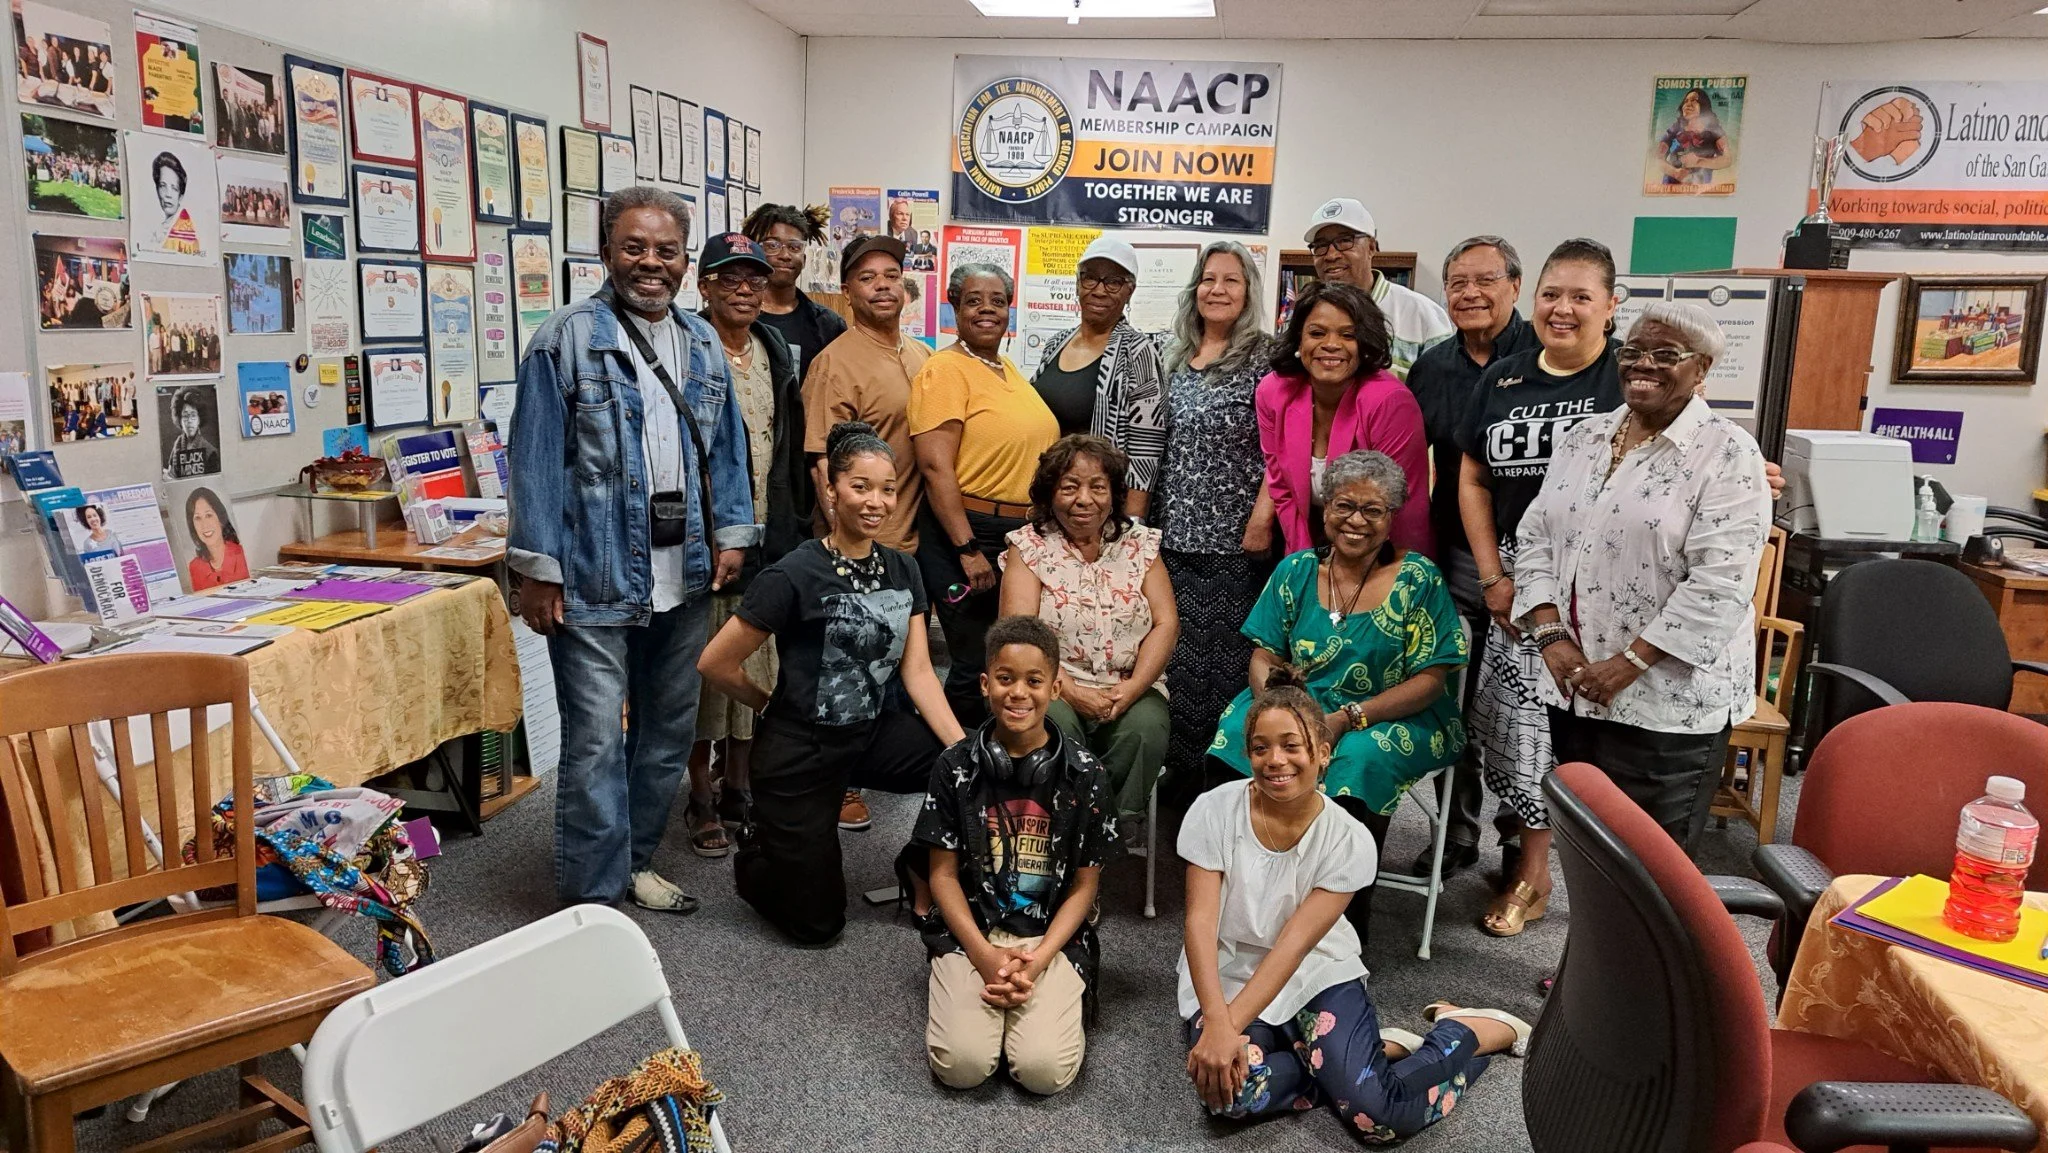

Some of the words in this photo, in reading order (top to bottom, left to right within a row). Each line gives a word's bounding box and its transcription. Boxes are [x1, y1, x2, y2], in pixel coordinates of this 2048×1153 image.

[995, 82, 1010, 95] THE
[1087, 69, 1270, 115] NAACP
[1657, 79, 1692, 89] SOMOS
[1693, 79, 1705, 88] EL
[1706, 78, 1745, 88] PUEBLO
[977, 91, 992, 107] FOR
[1015, 80, 1067, 119] ADVANCEMENT
[1060, 122, 1071, 134] OF
[1080, 117, 1179, 136] MEMBERSHIP
[1185, 121, 1274, 138] CAMPAIGN
[1945, 101, 2010, 142] Latino
[961, 106, 979, 161] ASSOCIATION
[998, 131, 1035, 145] NAACP
[1007, 151, 1025, 160] 1909
[1052, 139, 1072, 177] COLORED
[1094, 148, 1168, 175] JOIN
[1173, 150, 1254, 177] NOW!
[1965, 153, 1982, 178] of
[1983, 154, 1999, 178] the
[2002, 154, 2026, 178] San
[968, 164, 1002, 197] NATIONAL
[1026, 176, 1054, 198] PEOPLE
[1084, 182, 1176, 202] TOGETHER
[1183, 187, 1210, 203] WE
[1215, 188, 1253, 205] ARE
[1117, 206, 1214, 226] STRONGER
[1827, 198, 1888, 217] Working
[1892, 199, 1949, 215] towards
[1952, 199, 1999, 217] social,
[1838, 227, 1902, 240] 909-480-6267
[1027, 302, 1064, 311] REGISTER
[1508, 403, 1551, 420] CUT
[1555, 397, 1596, 416] THE
[263, 418, 291, 429] NAACP
[1875, 424, 1955, 441] #HEALTH4ALL
[179, 452, 204, 464] BLACK
[430, 452, 440, 462] TO
[440, 447, 458, 460] VOTE
[1492, 468, 1504, 477] CA
[117, 487, 153, 500] FREEDOM
[89, 566, 118, 620] DEMOCRACY
[110, 581, 126, 599] FOR
